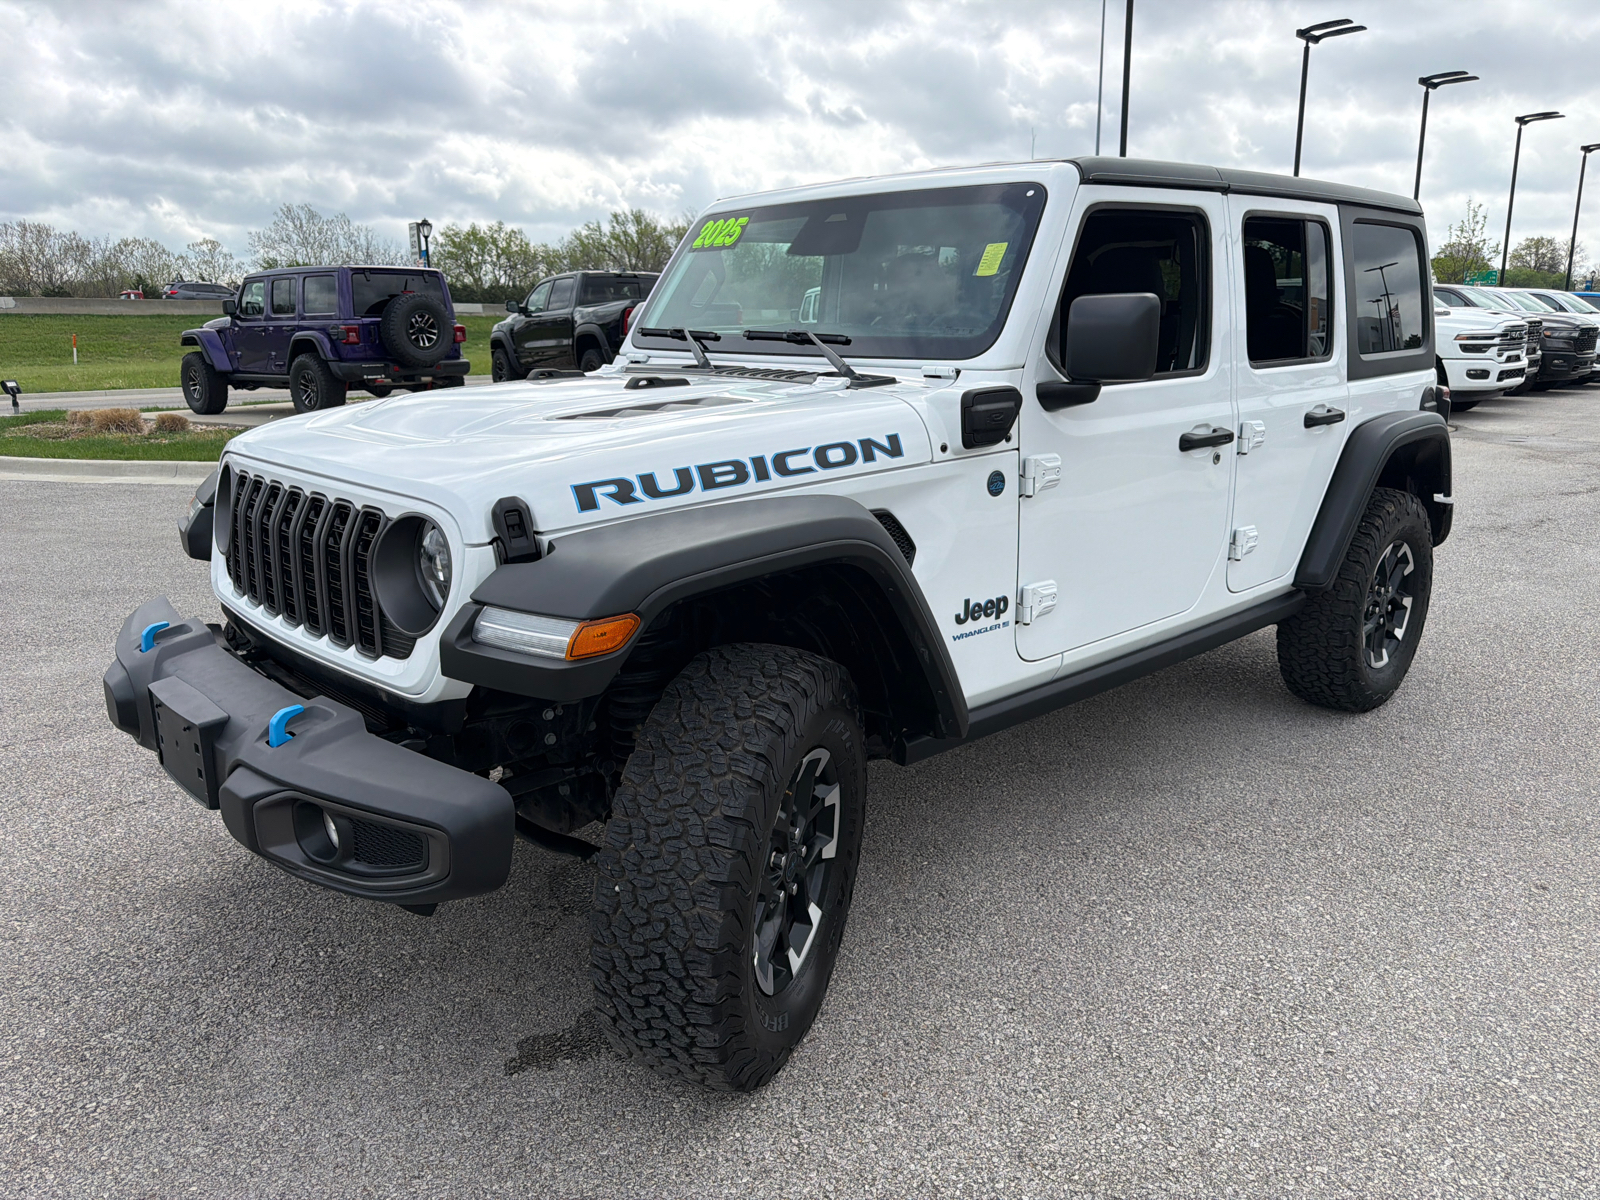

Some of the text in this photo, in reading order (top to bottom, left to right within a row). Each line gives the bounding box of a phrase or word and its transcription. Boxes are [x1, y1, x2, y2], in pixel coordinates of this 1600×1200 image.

[692, 216, 749, 248] 2025
[568, 432, 905, 514] RUBICON
[954, 595, 1009, 625] Jeep
[952, 623, 1001, 641] WRANGLER
